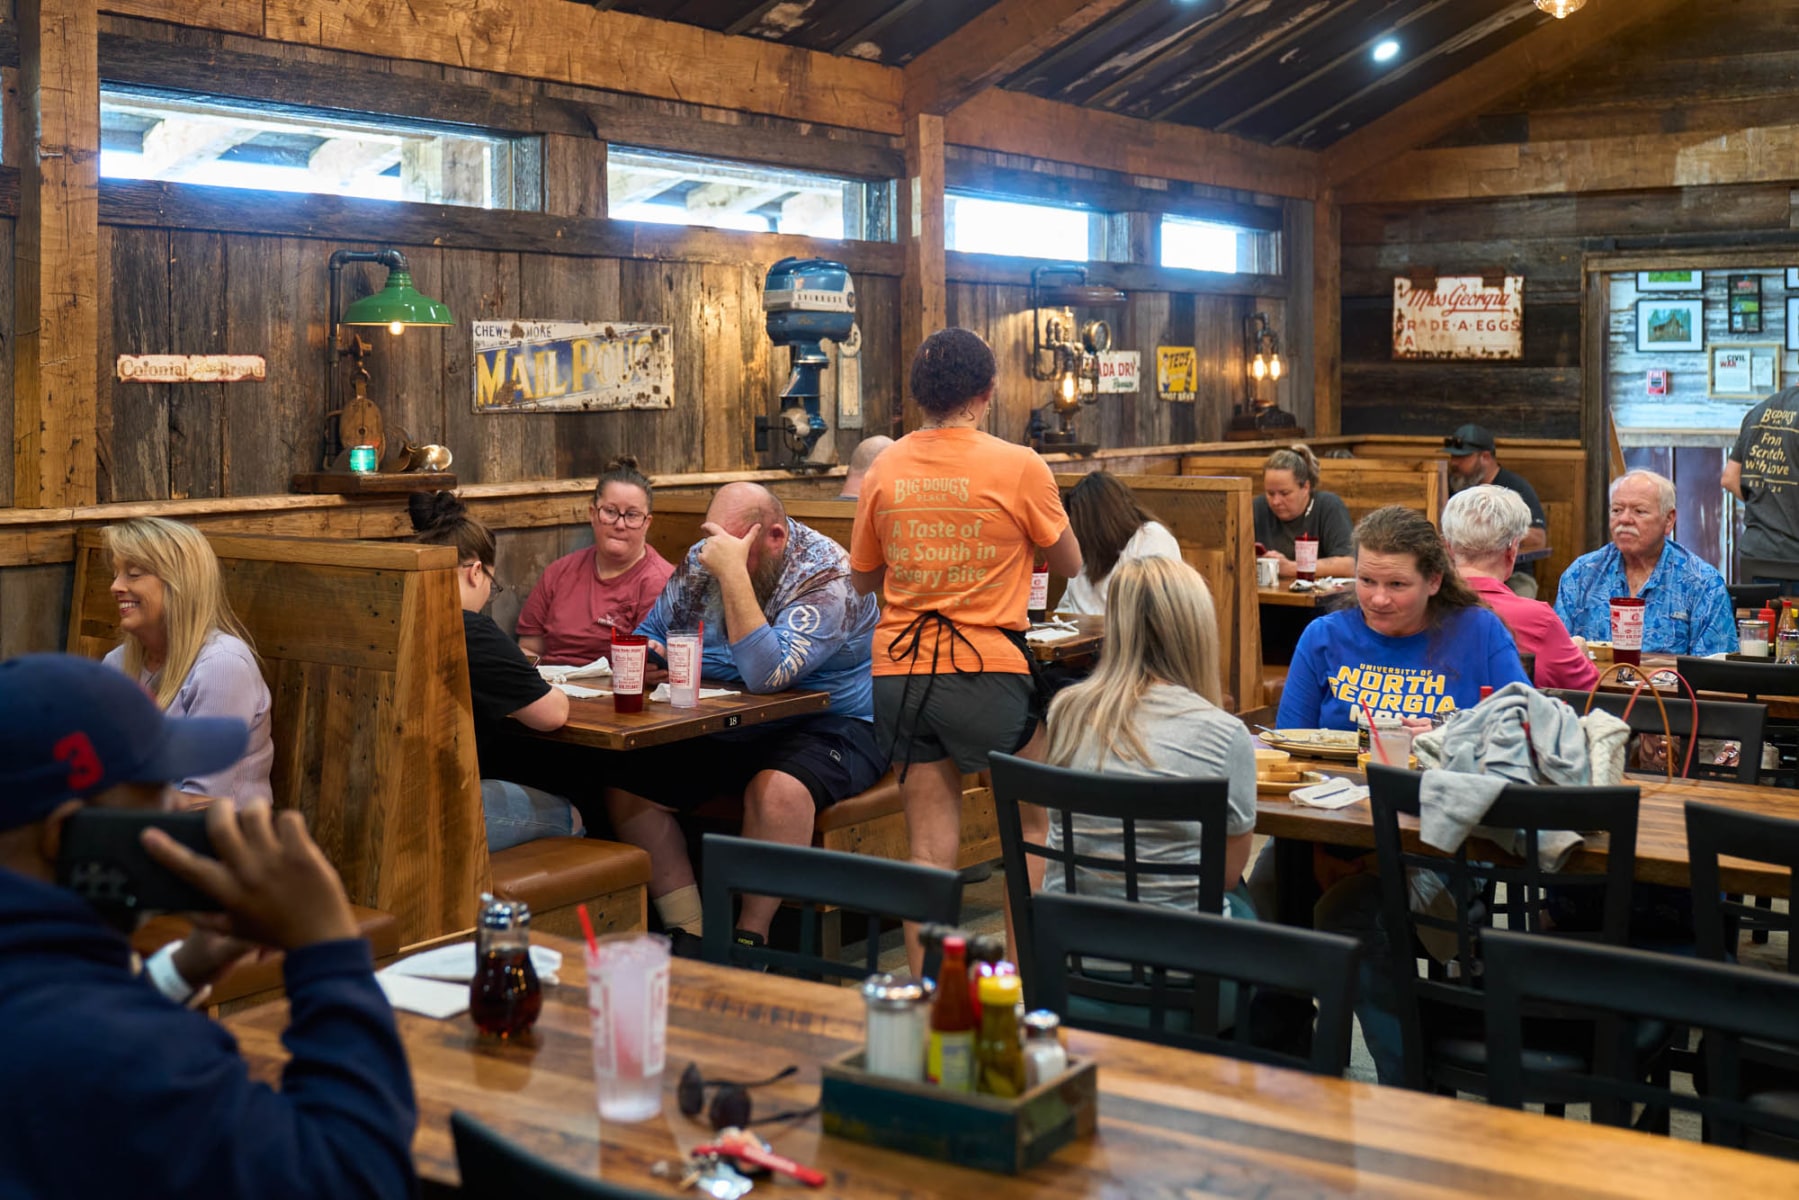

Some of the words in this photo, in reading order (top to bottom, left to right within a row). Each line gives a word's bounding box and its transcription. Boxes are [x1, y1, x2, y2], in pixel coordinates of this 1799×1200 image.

[1403, 288, 1447, 313] Miss
[1441, 284, 1511, 317] Georgia
[475, 325, 503, 338] CHEW
[119, 359, 188, 377] Colonial
[1118, 360, 1136, 377] DRY
[1719, 360, 1737, 368] WAR
[1726, 354, 1746, 362] CIVIL
[476, 348, 568, 406] MAIL
[570, 336, 655, 393] POUC
[893, 479, 920, 505] BIG
[922, 477, 971, 504] DOUG'S
[891, 520, 903, 539] A
[907, 519, 956, 539] Taste
[960, 518, 983, 538] of
[887, 542, 910, 561] the
[913, 542, 971, 562] South
[976, 541, 997, 560] in
[894, 564, 943, 590] Every
[947, 565, 988, 584] Bite
[1337, 665, 1447, 696] NORTH
[1359, 663, 1417, 677] UNIVERSITY
[1327, 676, 1457, 715] GEORGIA
[729, 716, 738, 726] 18
[53, 730, 105, 789] 3
